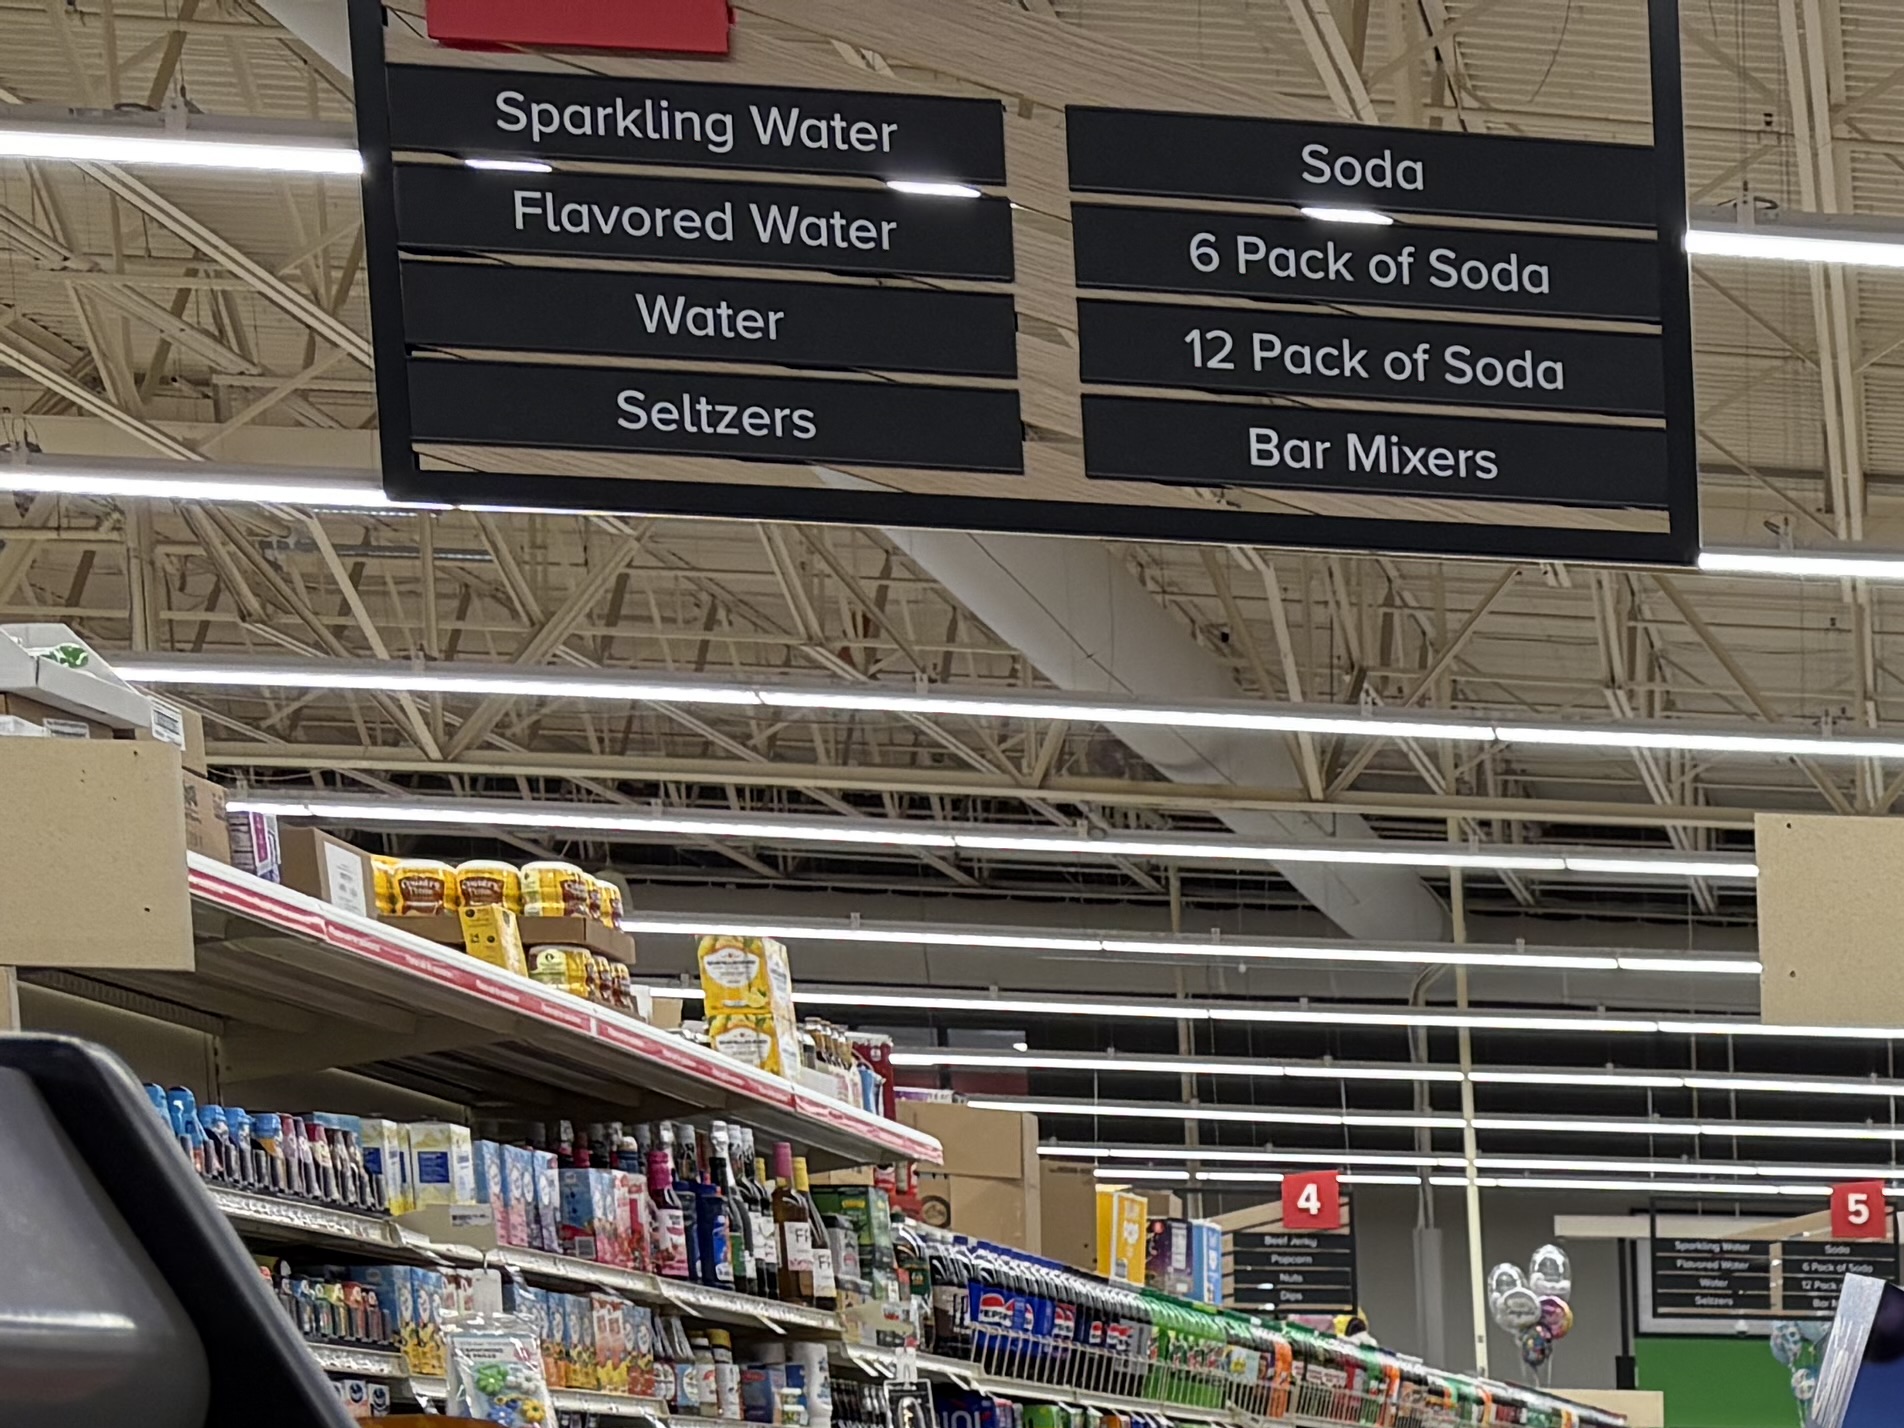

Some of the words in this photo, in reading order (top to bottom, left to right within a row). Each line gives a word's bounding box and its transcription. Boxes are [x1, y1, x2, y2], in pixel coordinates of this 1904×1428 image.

[496, 91, 735, 154] Sparkling
[750, 105, 897, 154] Water
[1300, 144, 1425, 193] Soda
[513, 189, 742, 246] Flavored
[751, 200, 897, 251] Water
[1189, 232, 1219, 275] 6
[1237, 233, 1356, 284] Pack
[1368, 237, 1417, 285] of
[1428, 247, 1551, 297] Soda
[636, 292, 784, 343] Water
[1185, 329, 1237, 372] 12
[1253, 332, 1369, 379] Pack
[1383, 335, 1432, 384] of
[1443, 343, 1565, 392] Soda
[616, 390, 818, 443] Seltzers
[1248, 426, 1331, 472] Bar
[1348, 434, 1498, 483] Mixers
[1297, 1183, 1321, 1215] 4
[1848, 1193, 1870, 1224] 5
[1271, 1254, 1312, 1264] Popcorn
[1722, 1242, 1750, 1251] Water
[1280, 1274, 1303, 1282] Nuts
[1721, 1260, 1749, 1270] Water
[1811, 1262, 1834, 1272] Pack
[1836, 1262, 1846, 1272] of
[1280, 1290, 1302, 1301] Dips
[1700, 1278, 1728, 1288] Water
